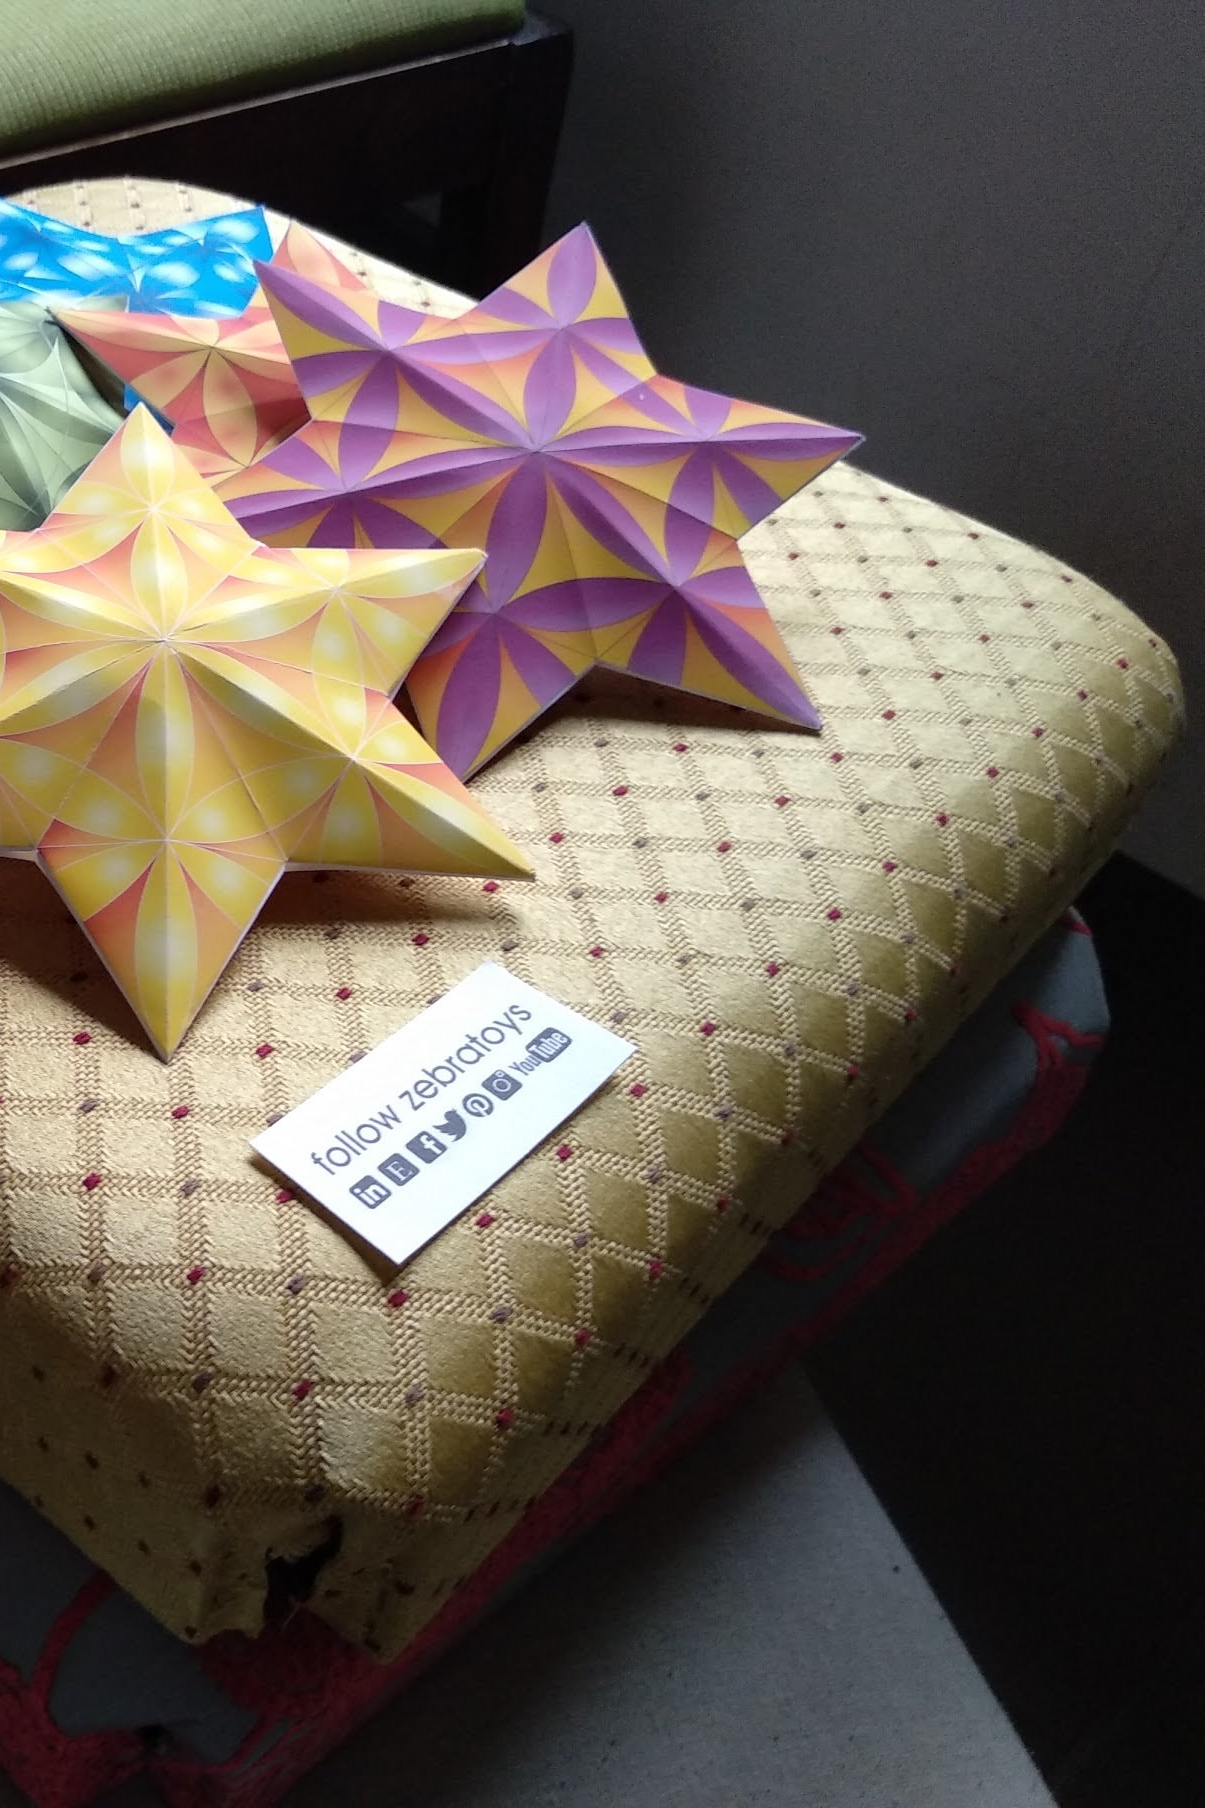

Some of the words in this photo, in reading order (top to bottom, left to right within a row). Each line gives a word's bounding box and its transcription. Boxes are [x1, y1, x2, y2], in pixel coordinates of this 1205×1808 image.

[310, 1104, 402, 1175] follow
[398, 1004, 532, 1111] zebratoys
[351, 1180, 389, 1207] in
[508, 1028, 572, 1076] YouTube
